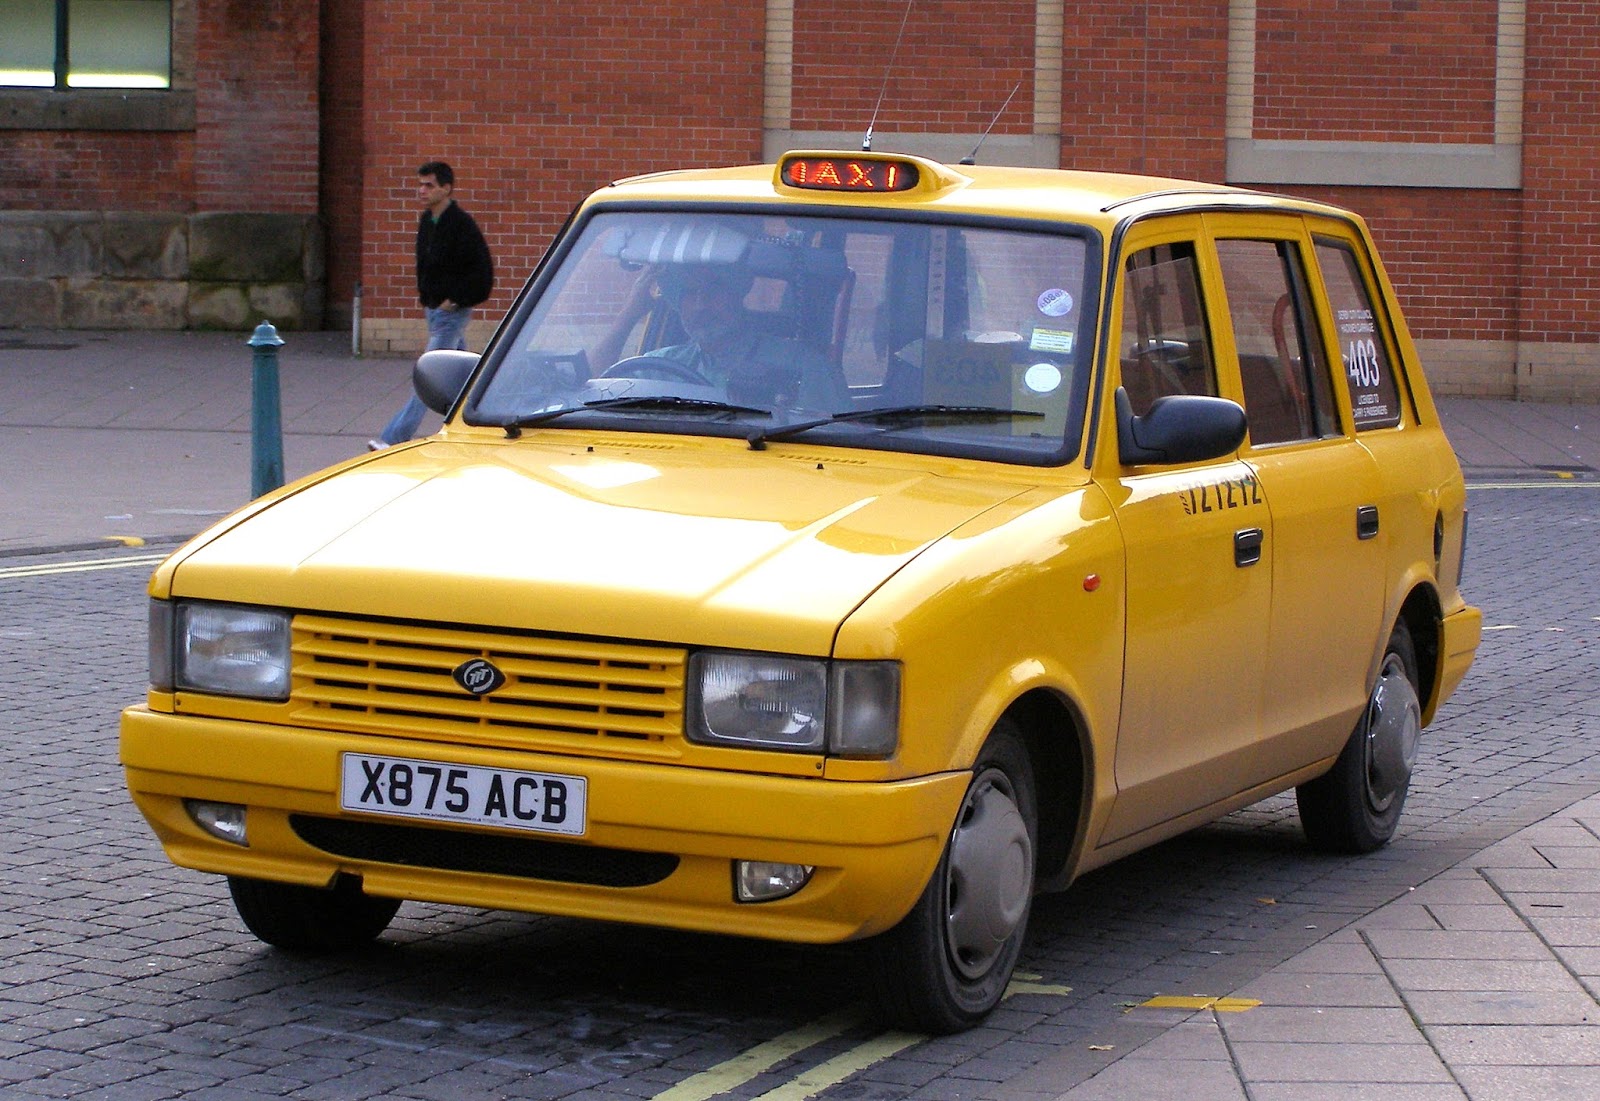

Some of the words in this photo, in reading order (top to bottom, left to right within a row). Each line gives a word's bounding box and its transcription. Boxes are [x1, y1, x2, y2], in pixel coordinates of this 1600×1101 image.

[790, 161, 896, 189] TAXI
[1350, 339, 1380, 387] 403
[360, 760, 470, 813] X875
[484, 774, 567, 824] ACB
